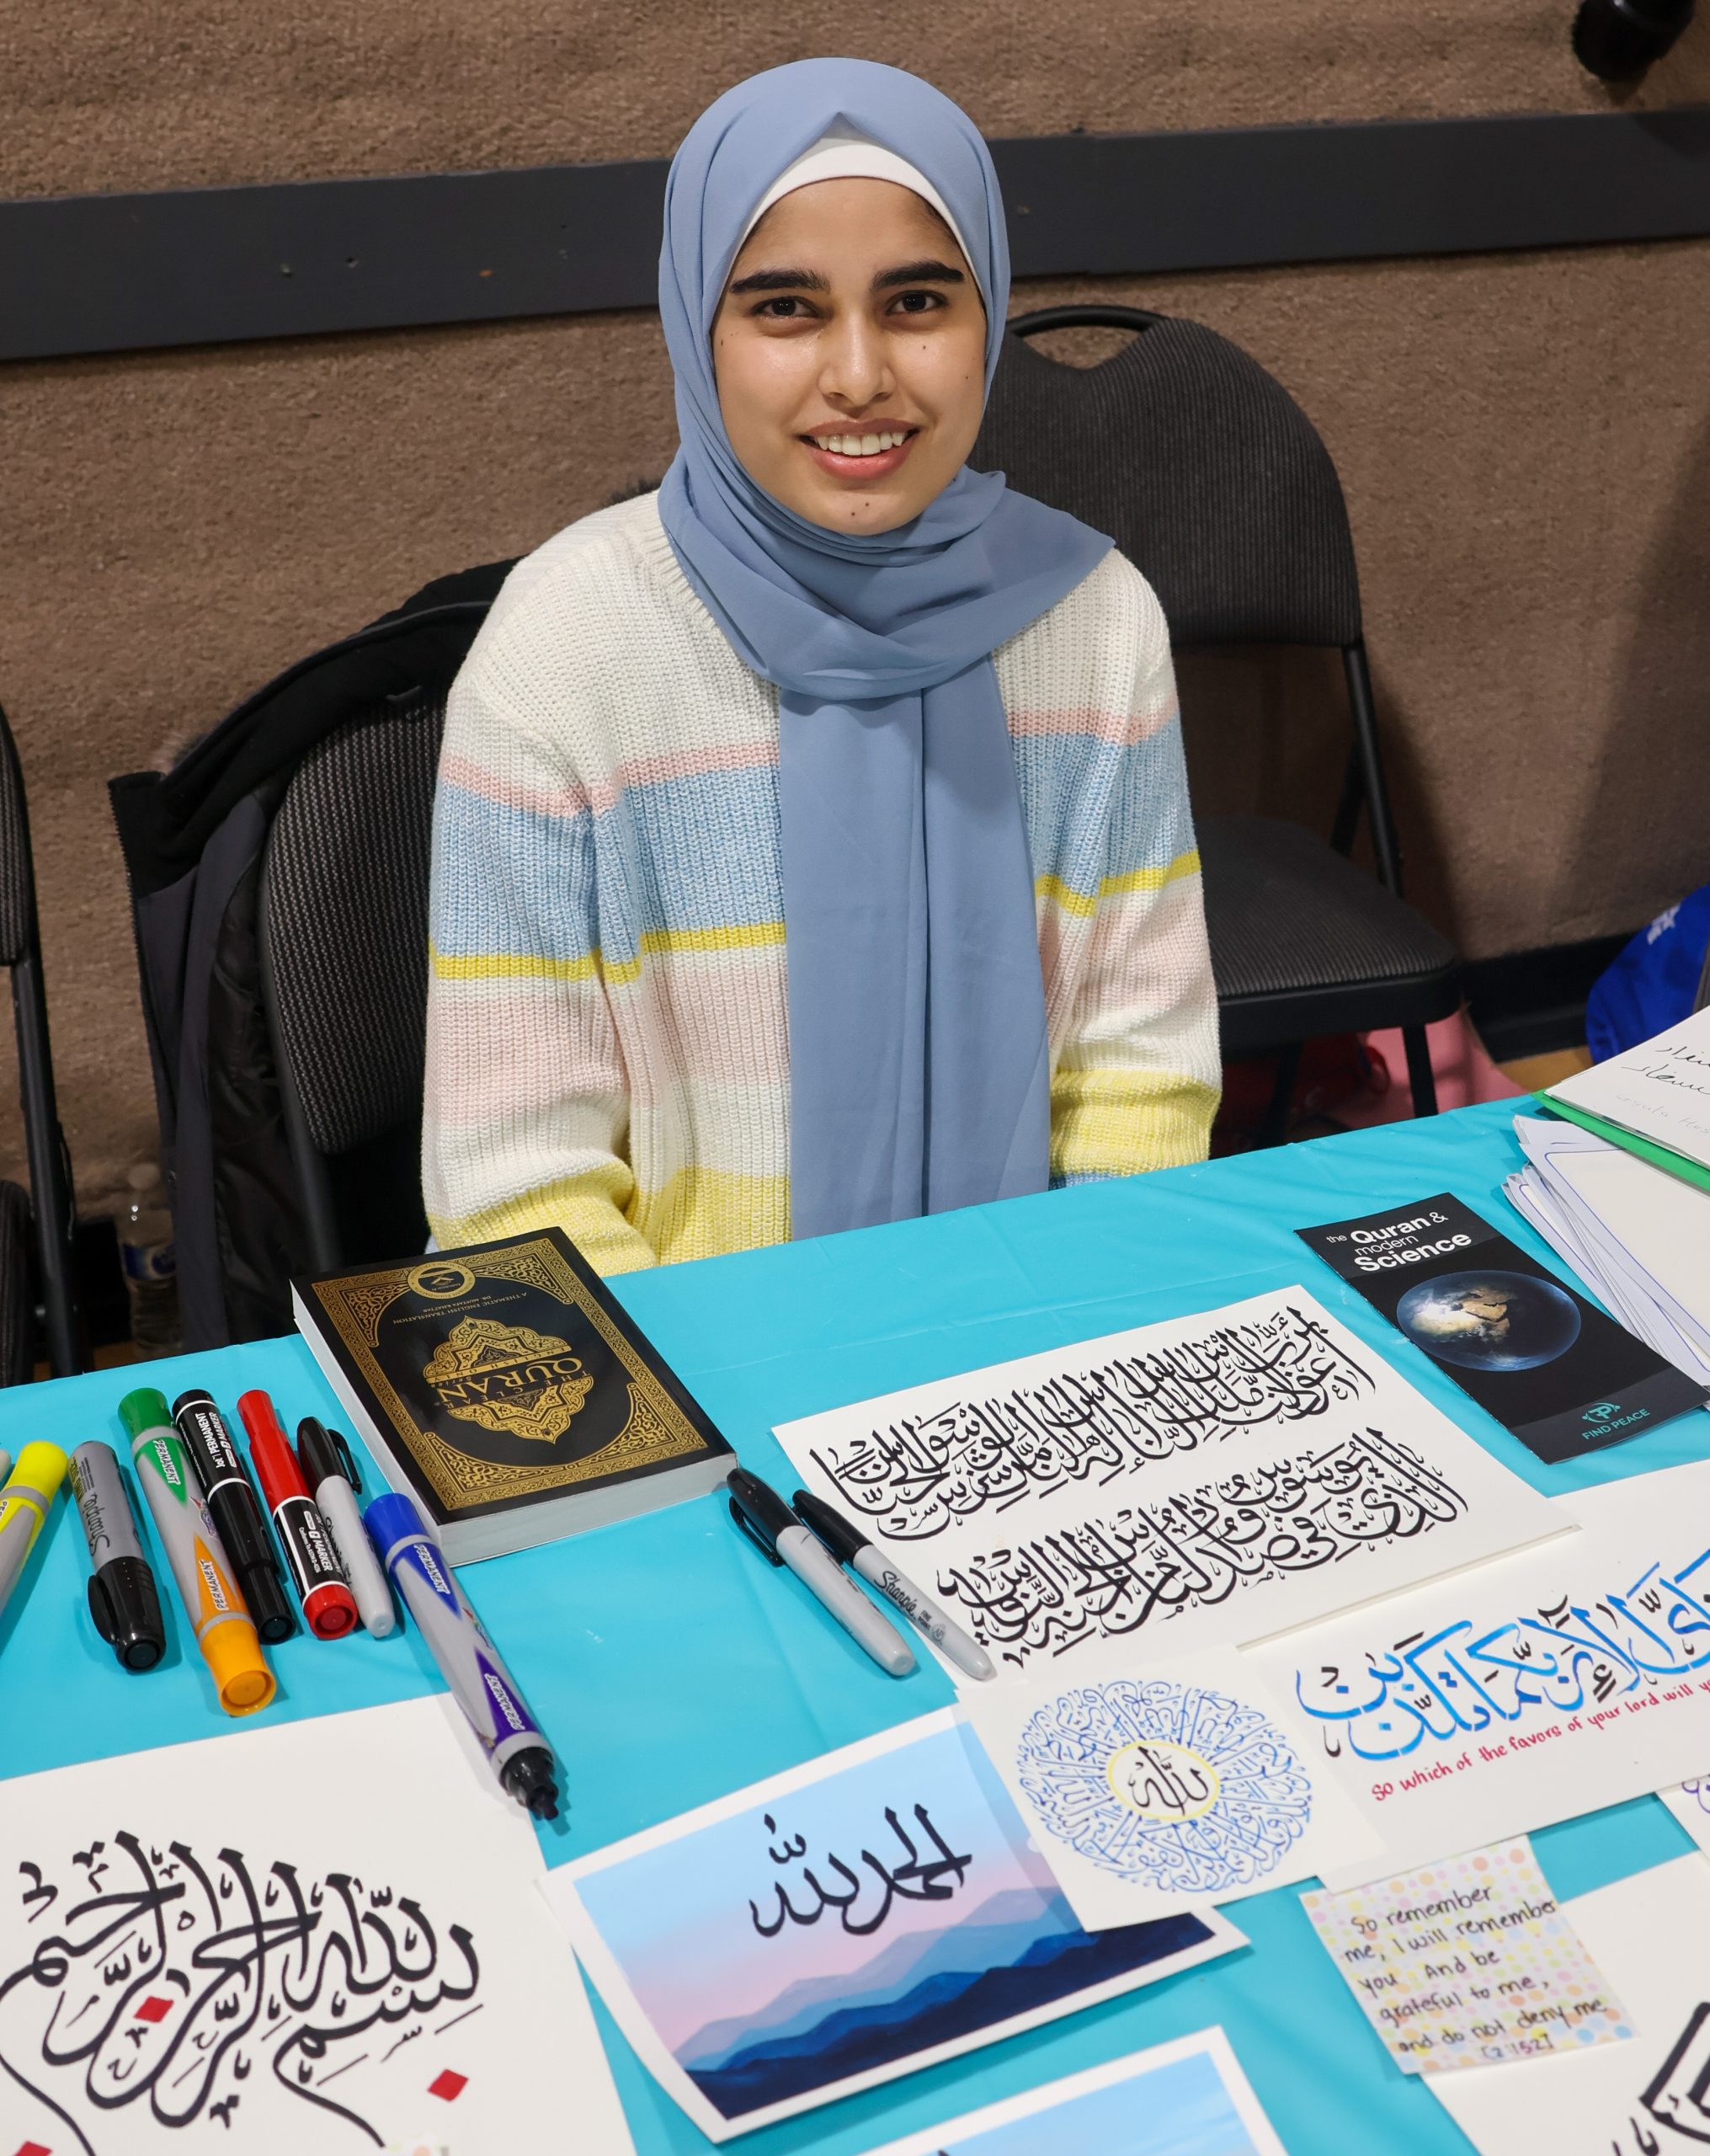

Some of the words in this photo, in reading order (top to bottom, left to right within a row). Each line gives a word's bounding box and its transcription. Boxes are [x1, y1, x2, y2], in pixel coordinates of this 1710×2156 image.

[1326, 1235, 1347, 1244] the
[1350, 1217, 1431, 1245] Quran
[1429, 1212, 1449, 1224] &
[1355, 1235, 1419, 1256] modern
[1354, 1233, 1472, 1272] Science
[392, 1310, 445, 1325] TRANSLATION
[447, 1303, 482, 1315] ENGLISH
[482, 1294, 522, 1307] THEMATIC
[544, 1369, 590, 1387] THE
[443, 1386, 524, 1409] CLEAR
[195, 1412, 221, 1455] PERMANENT
[209, 1412, 227, 1442] MARKER
[1582, 1425, 1611, 1440] FIND
[1611, 1408, 1651, 1429] PEACE
[153, 1439, 182, 1486] PERMANENT
[83, 1492, 110, 1556] Sharpie
[313, 1539, 333, 1572] MARKER
[413, 1543, 450, 1594] PERMANENT
[199, 1559, 229, 1610] PERMANENT
[873, 1571, 917, 1618] Sharpie
[484, 1673, 525, 1731] PERMANENT
[1372, 1782, 1394, 1801] So
[1399, 1760, 1453, 1793] which
[1456, 1752, 1473, 1771] of
[1479, 1741, 1508, 1764] the
[1509, 1724, 1562, 1752] favors
[1567, 1716, 1583, 1732] of
[1587, 1707, 1621, 1730] your
[1624, 1691, 1659, 1714] lord
[1662, 1683, 1694, 1703] will
[1351, 1916, 1379, 1935] So
[1386, 1886, 1493, 1927] remember
[1345, 1944, 1386, 1963] me,
[1408, 1928, 1449, 1951] will
[1424, 1956, 1467, 1979] And
[1471, 1950, 1500, 1967] be
[1379, 1993, 1462, 2029] grateful
[1469, 1985, 1490, 2001] to
[1499, 1975, 1550, 1996] me,
[1398, 2034, 1435, 2053] and
[1441, 2028, 1466, 2047] do
[1471, 2019, 1507, 2041] not
[1516, 2006, 1573, 2030] deny
[1574, 1997, 1609, 2017] me
